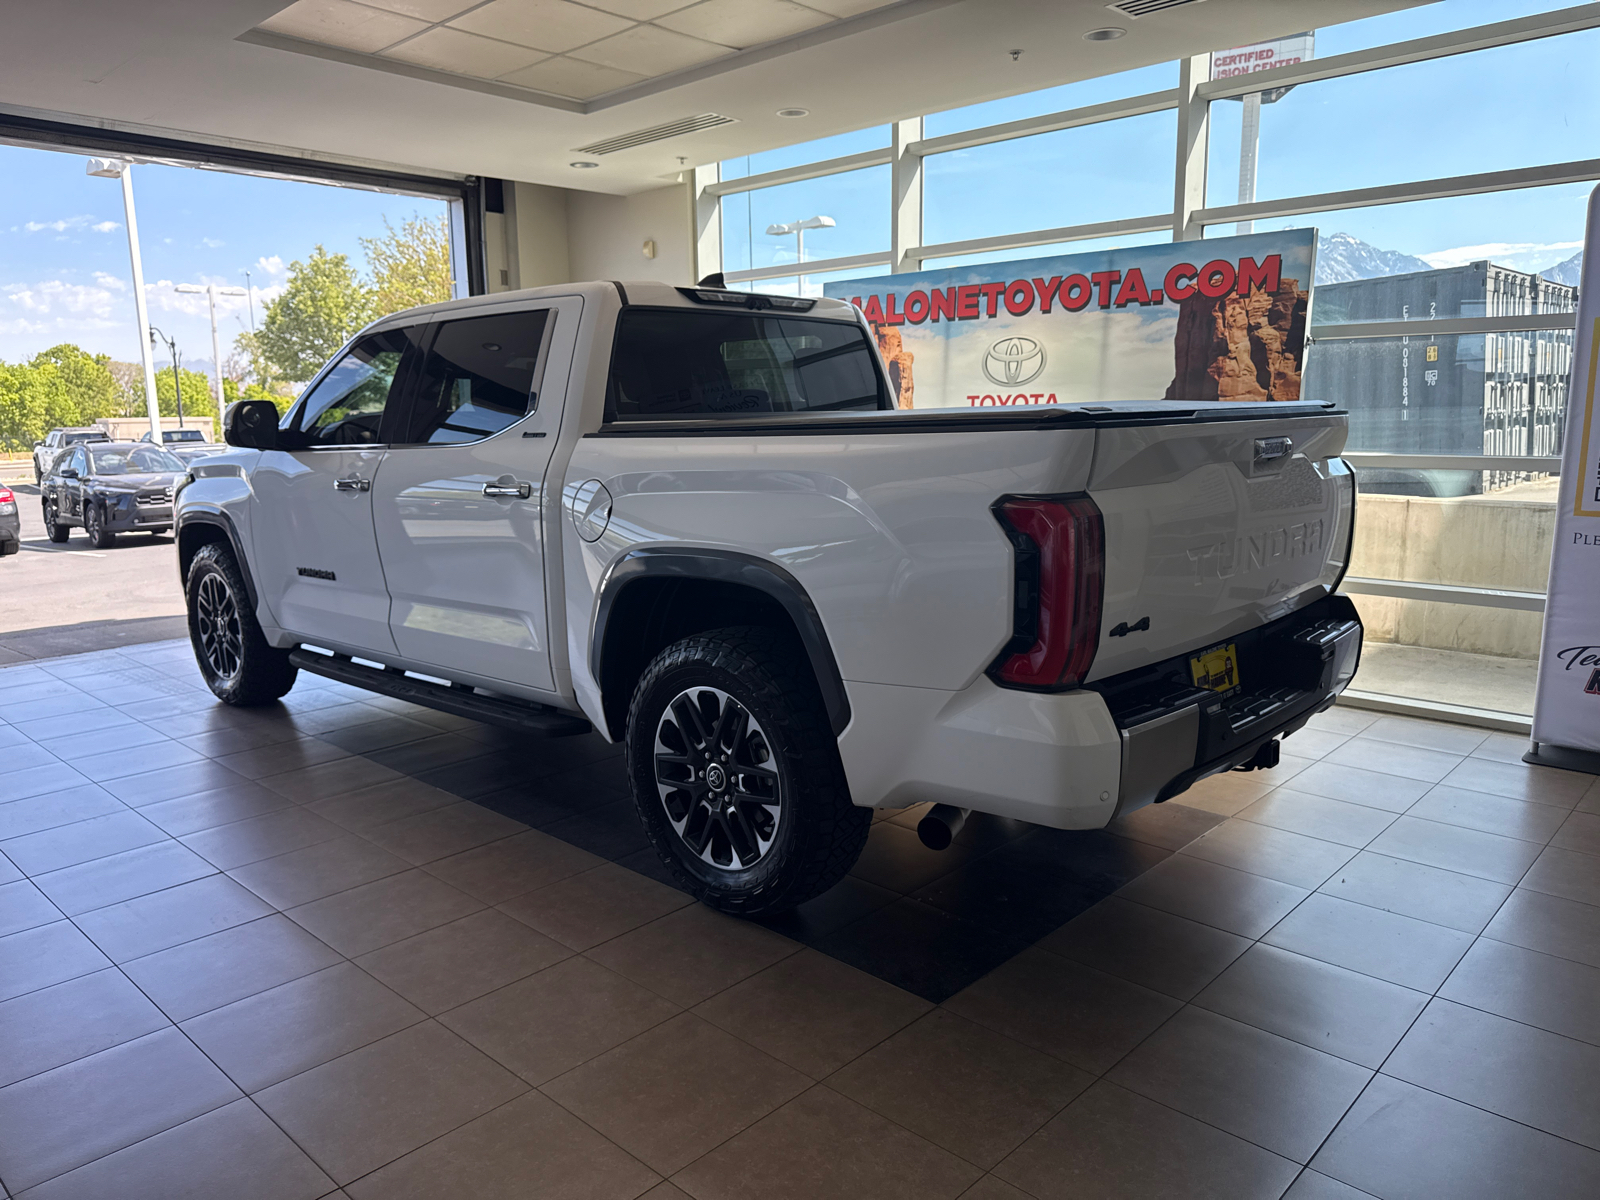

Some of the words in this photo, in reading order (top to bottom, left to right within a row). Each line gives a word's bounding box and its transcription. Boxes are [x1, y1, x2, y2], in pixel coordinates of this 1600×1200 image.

[1214, 49, 1274, 67] CERTIFIED
[1213, 65, 1250, 80] ISION
[967, 393, 1058, 407] TOYOTA
[1186, 518, 1324, 587] TUNDRA
